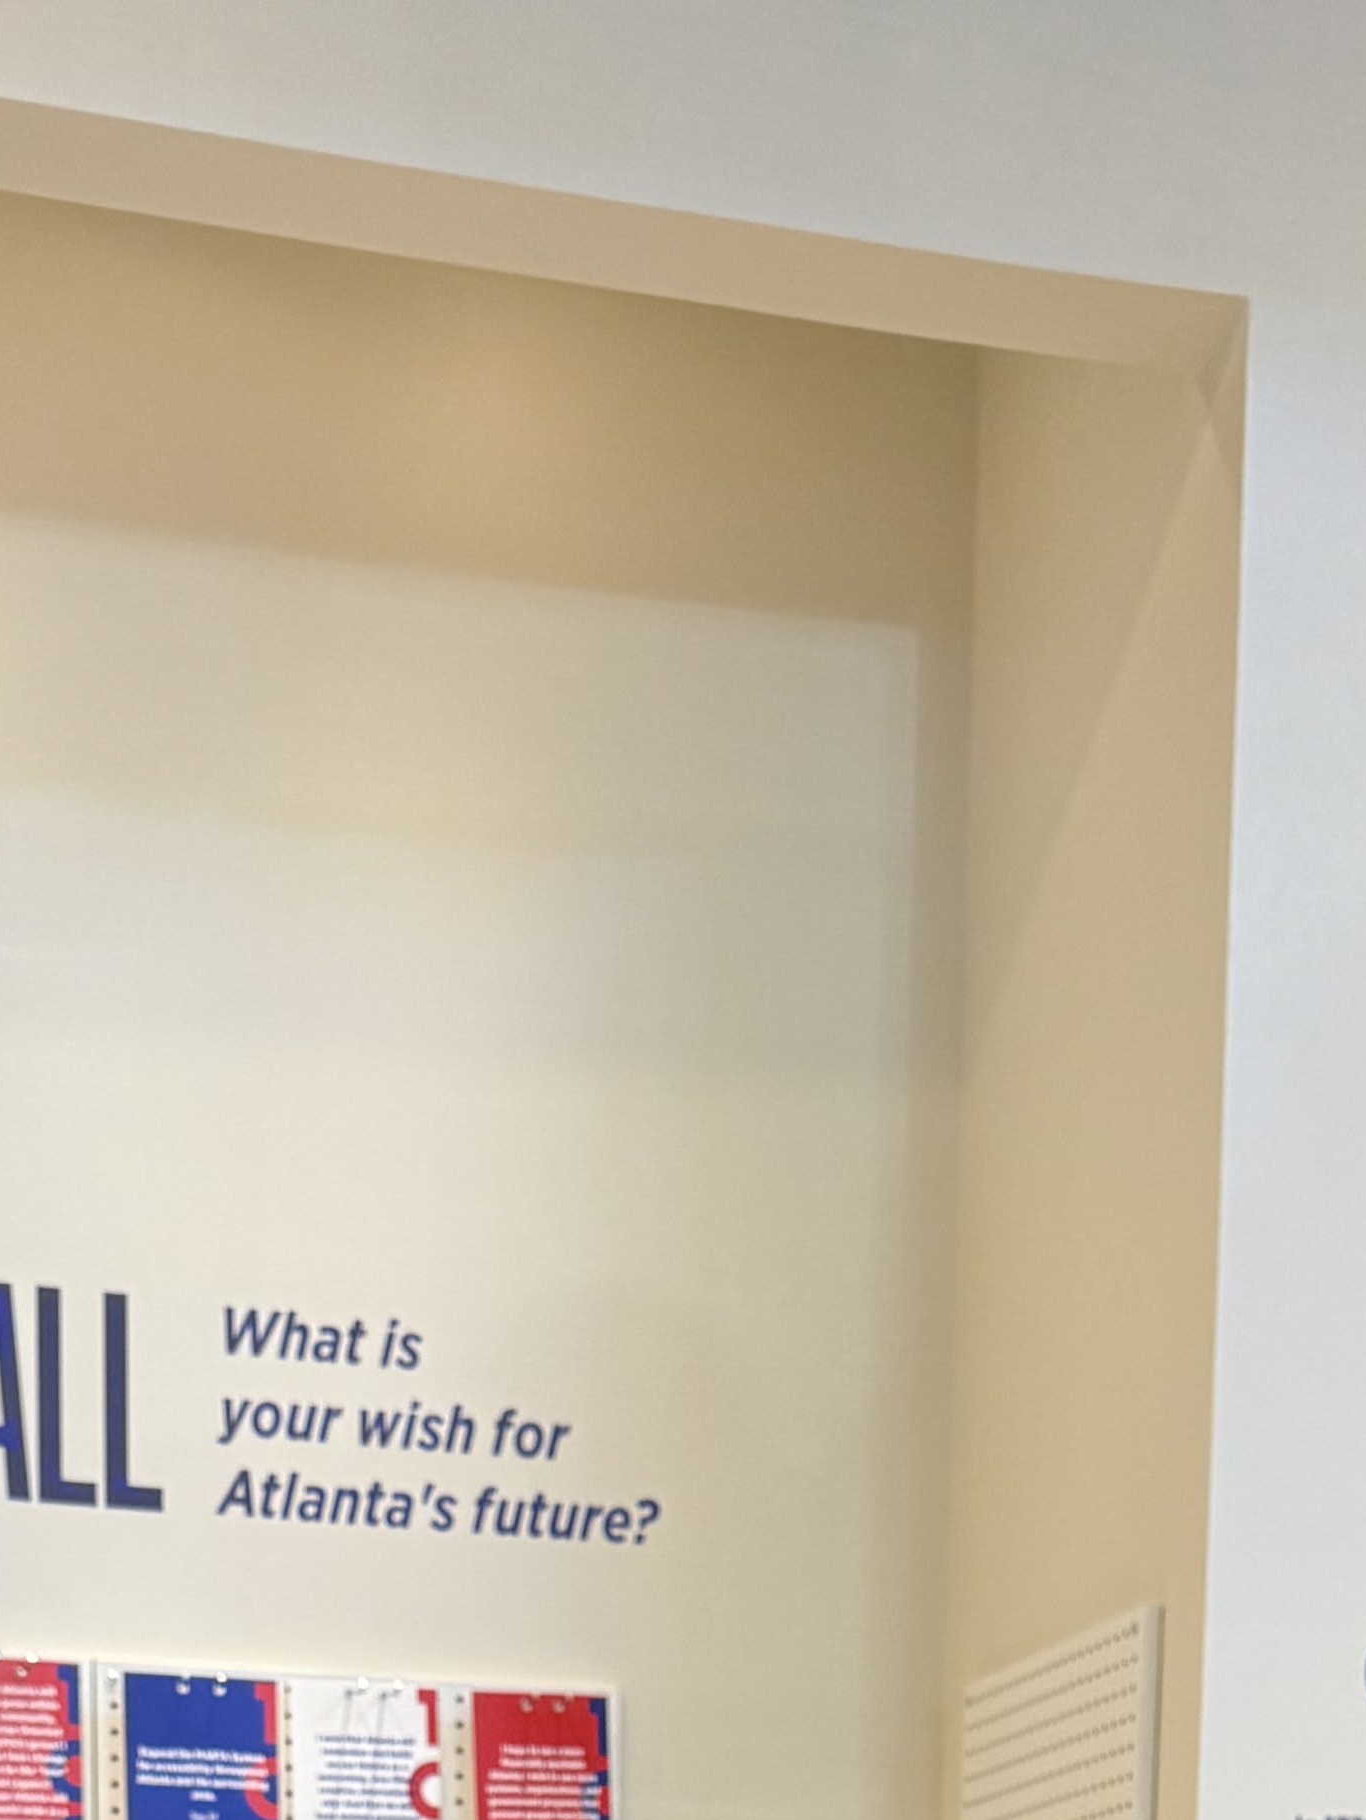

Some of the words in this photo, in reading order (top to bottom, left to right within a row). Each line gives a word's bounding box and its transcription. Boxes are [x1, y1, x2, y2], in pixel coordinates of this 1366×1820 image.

[222, 1304, 367, 1371] What
[382, 1319, 423, 1372] is
[217, 1391, 341, 1450] your
[356, 1401, 476, 1457] wish
[491, 1411, 570, 1463] for
[217, 1469, 455, 1534] Atlanta's
[469, 1487, 662, 1547] future?
